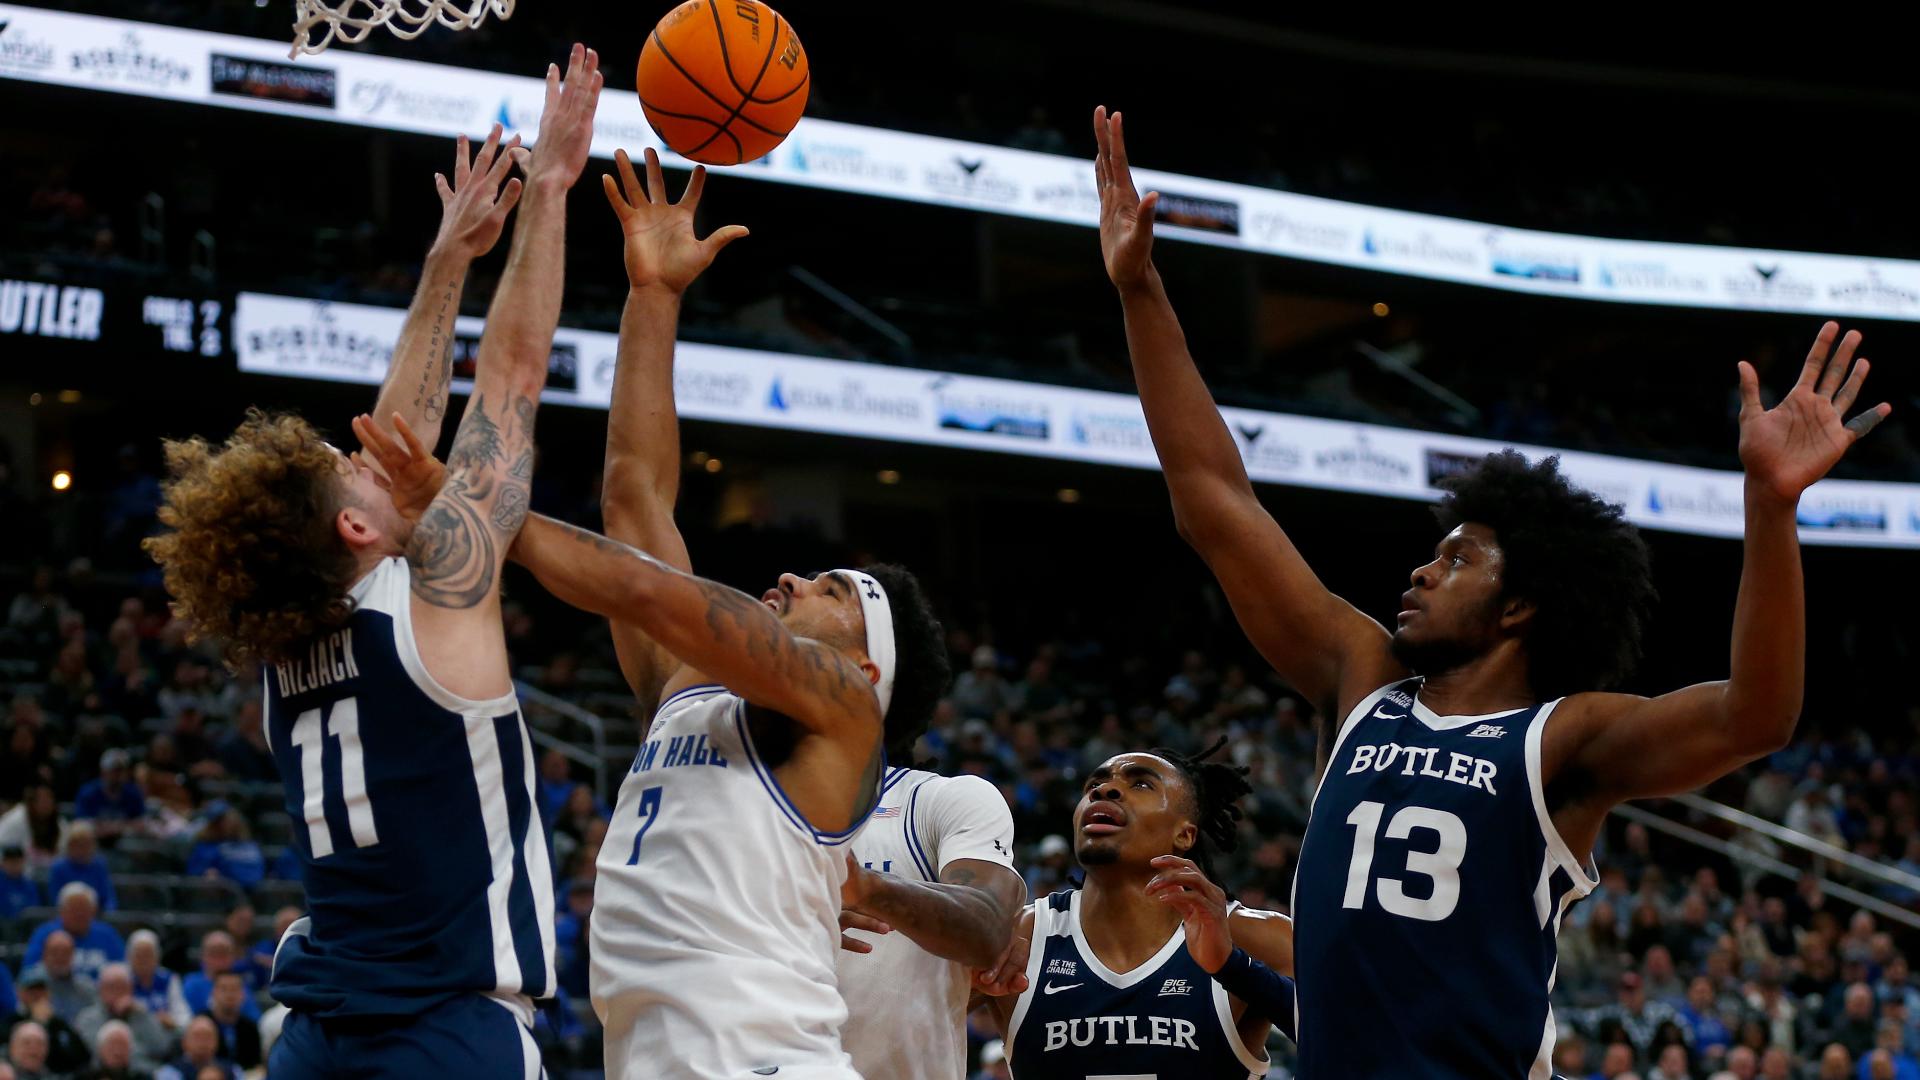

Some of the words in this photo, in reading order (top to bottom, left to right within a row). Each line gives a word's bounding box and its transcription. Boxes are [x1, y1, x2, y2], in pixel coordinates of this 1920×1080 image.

[291, 696, 379, 860] 11
[1346, 743, 1498, 796] BUTLER
[625, 785, 663, 866] 7
[1342, 800, 1468, 922] 13
[1046, 966, 1077, 976] CHANGE
[1050, 959, 1061, 967] BE
[1061, 960, 1077, 969] THE
[1163, 978, 1188, 987] BIG
[1044, 1015, 1200, 1052] BUTLER
